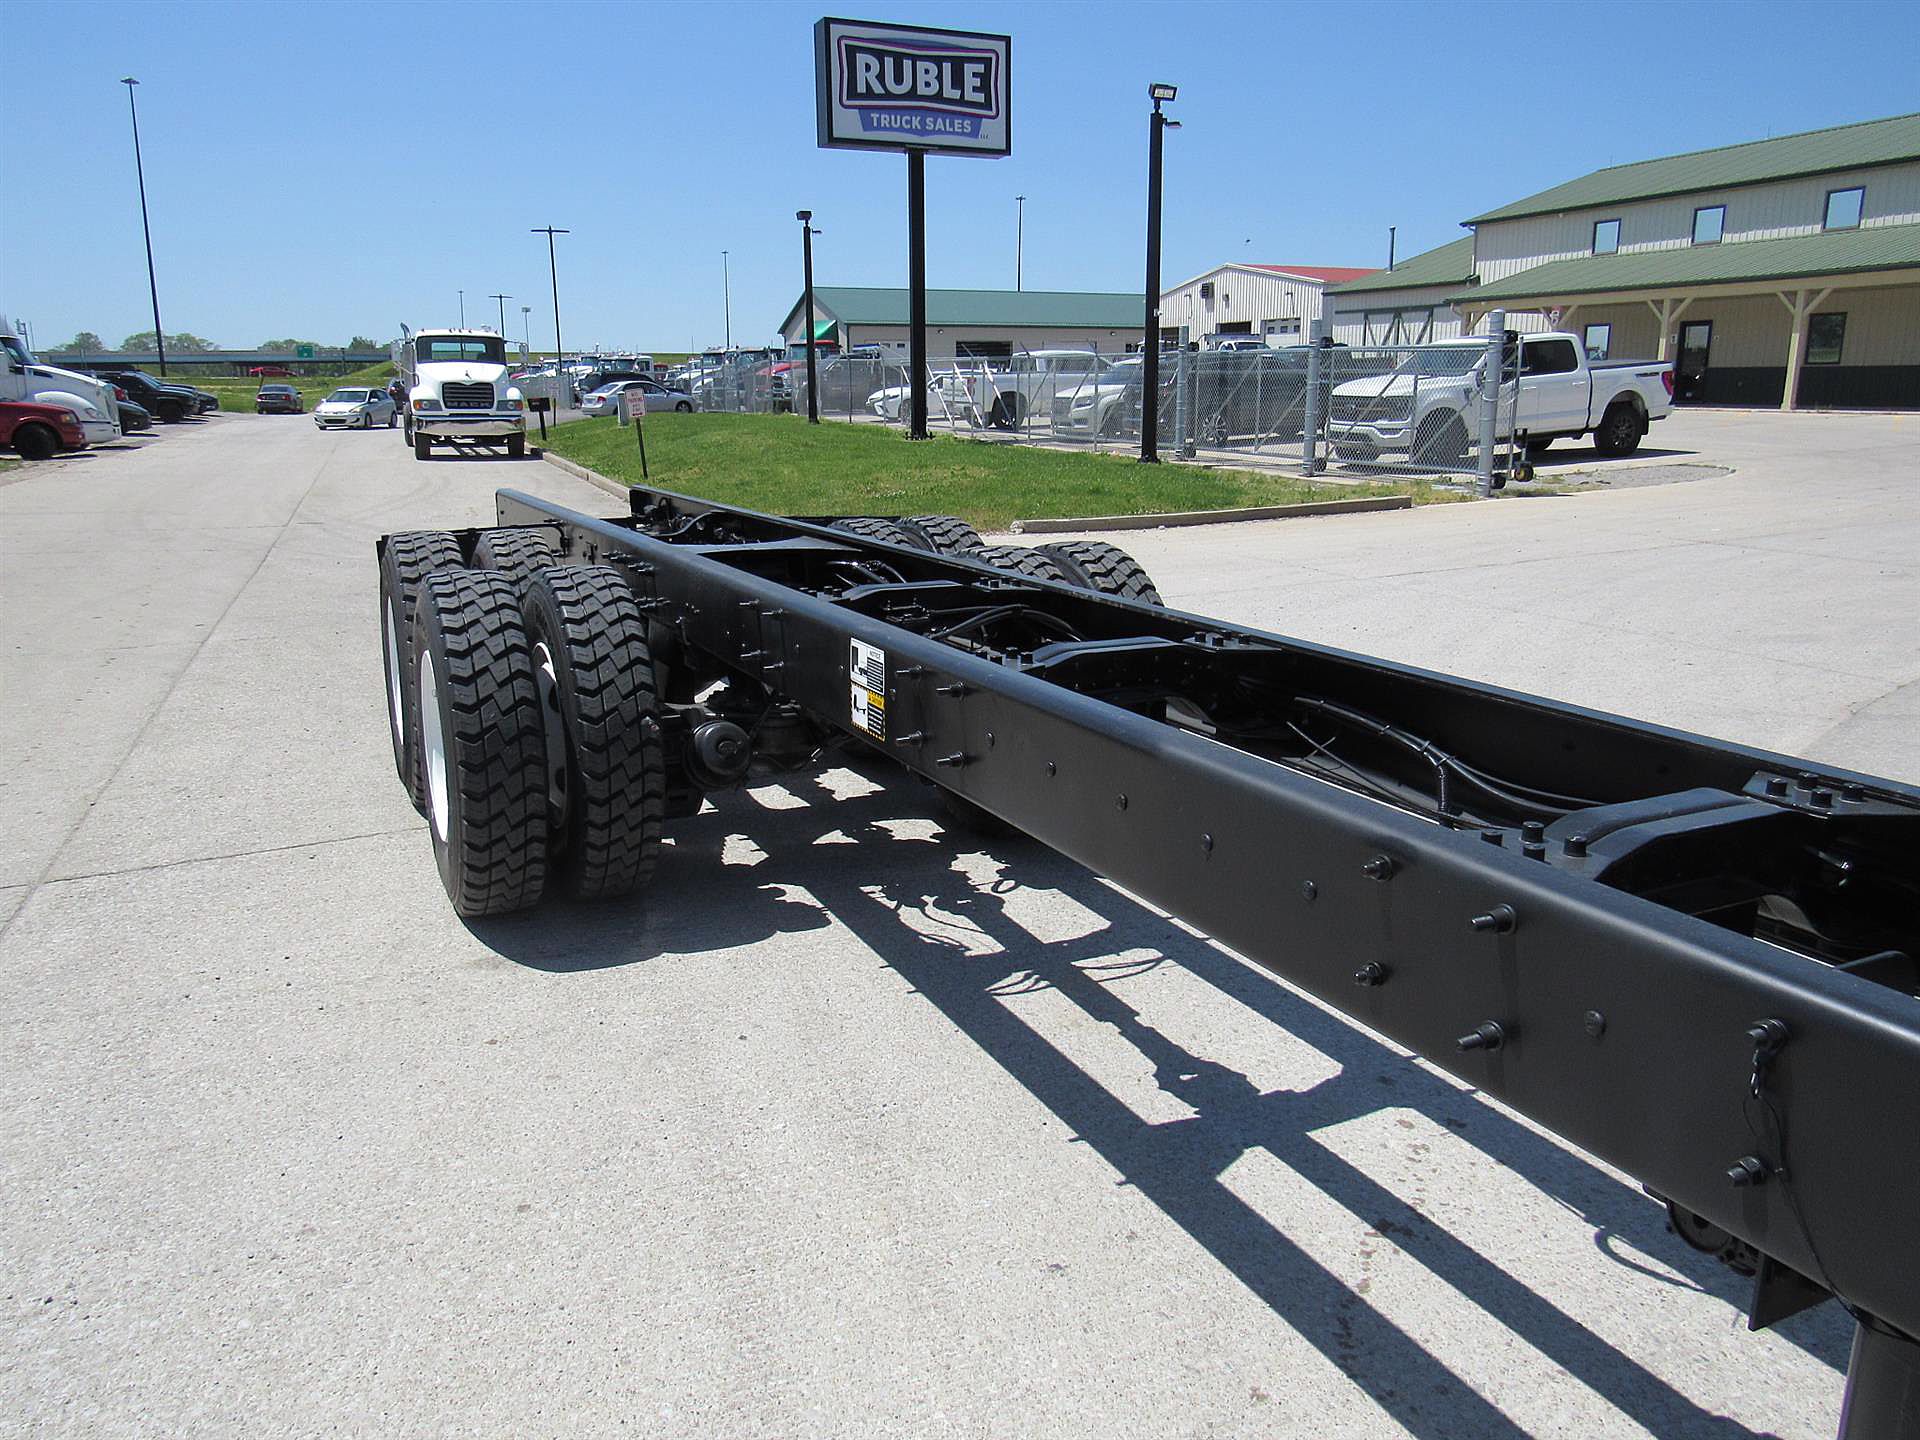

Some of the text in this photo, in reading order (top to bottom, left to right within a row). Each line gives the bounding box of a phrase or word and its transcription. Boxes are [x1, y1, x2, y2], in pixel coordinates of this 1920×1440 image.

[856, 53, 985, 103] RUBLE
[870, 112, 972, 133] TRUCK SALES
